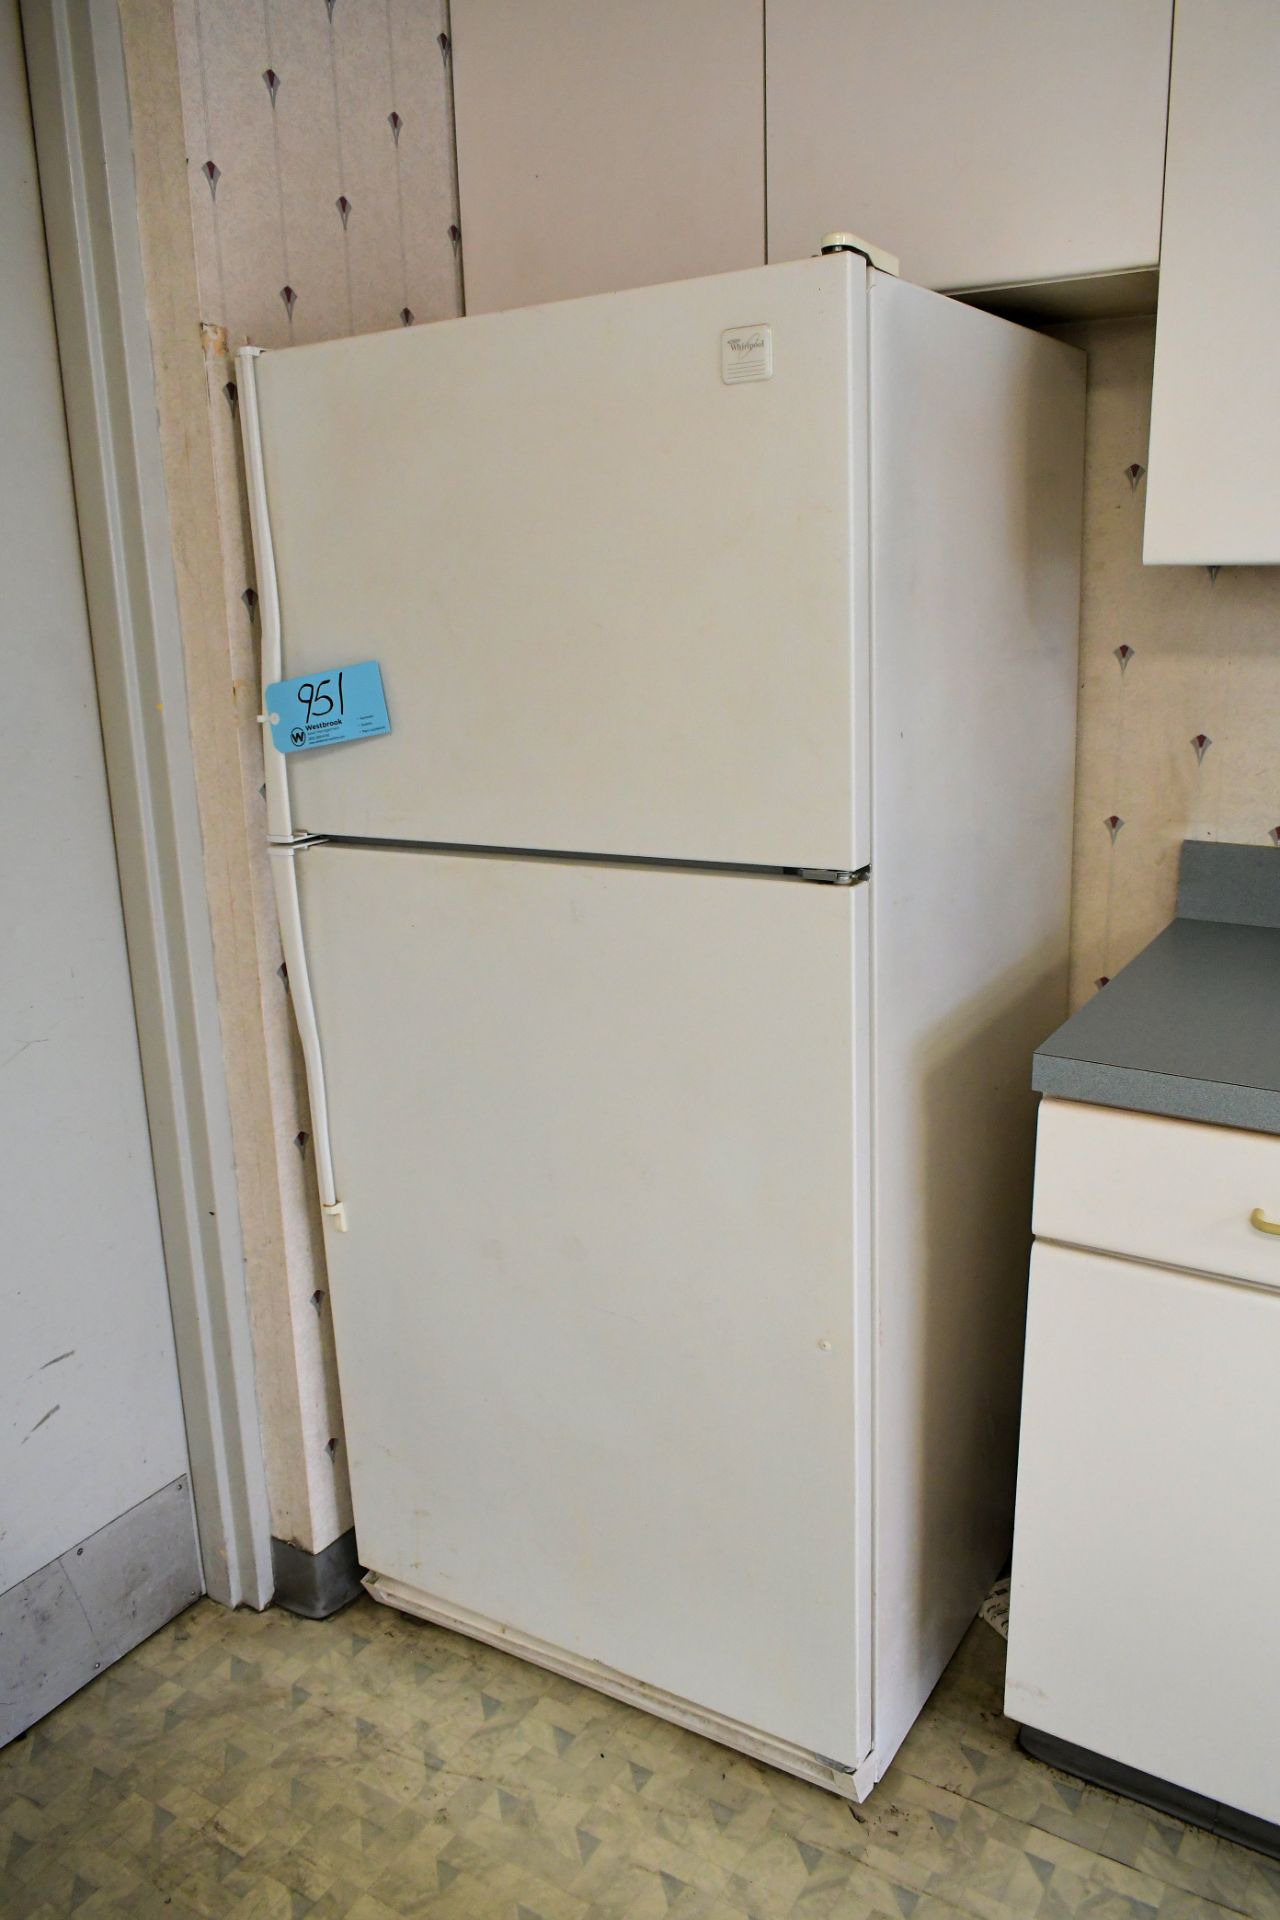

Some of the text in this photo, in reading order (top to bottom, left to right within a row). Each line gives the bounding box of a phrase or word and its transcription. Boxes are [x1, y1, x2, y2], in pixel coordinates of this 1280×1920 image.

[729, 338, 765, 351] Whirlpool
[297, 671, 344, 724] 951
[305, 718, 343, 731] Westbrook
[291, 731, 305, 743] W
